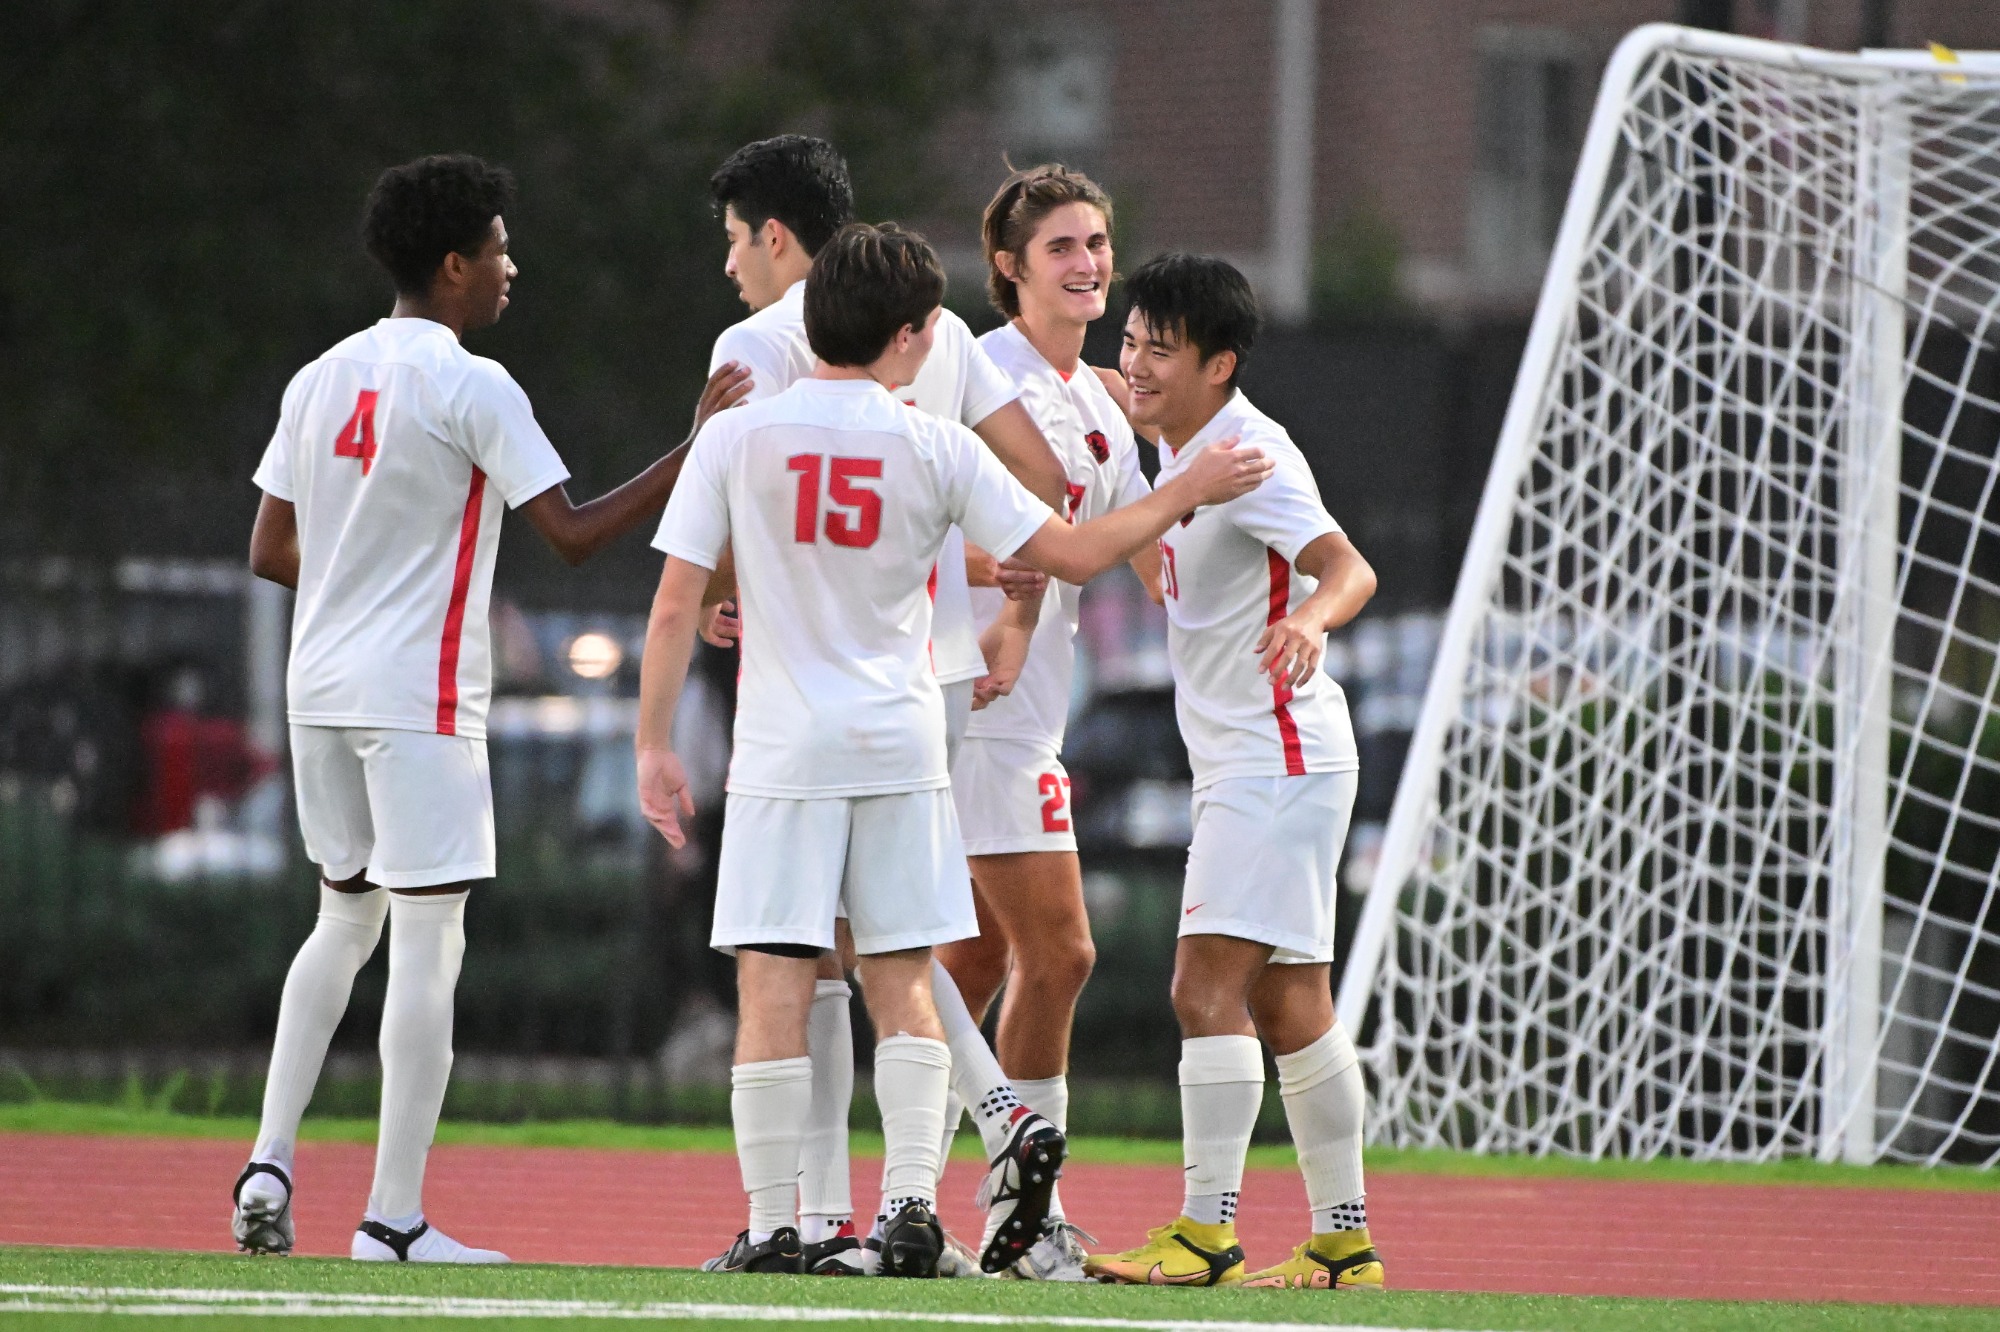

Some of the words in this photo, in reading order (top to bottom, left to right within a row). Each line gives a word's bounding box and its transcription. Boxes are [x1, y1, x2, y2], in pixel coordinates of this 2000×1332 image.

[334, 389, 380, 476] 4
[787, 453, 884, 550] 15
[1038, 772, 1072, 833] 2
